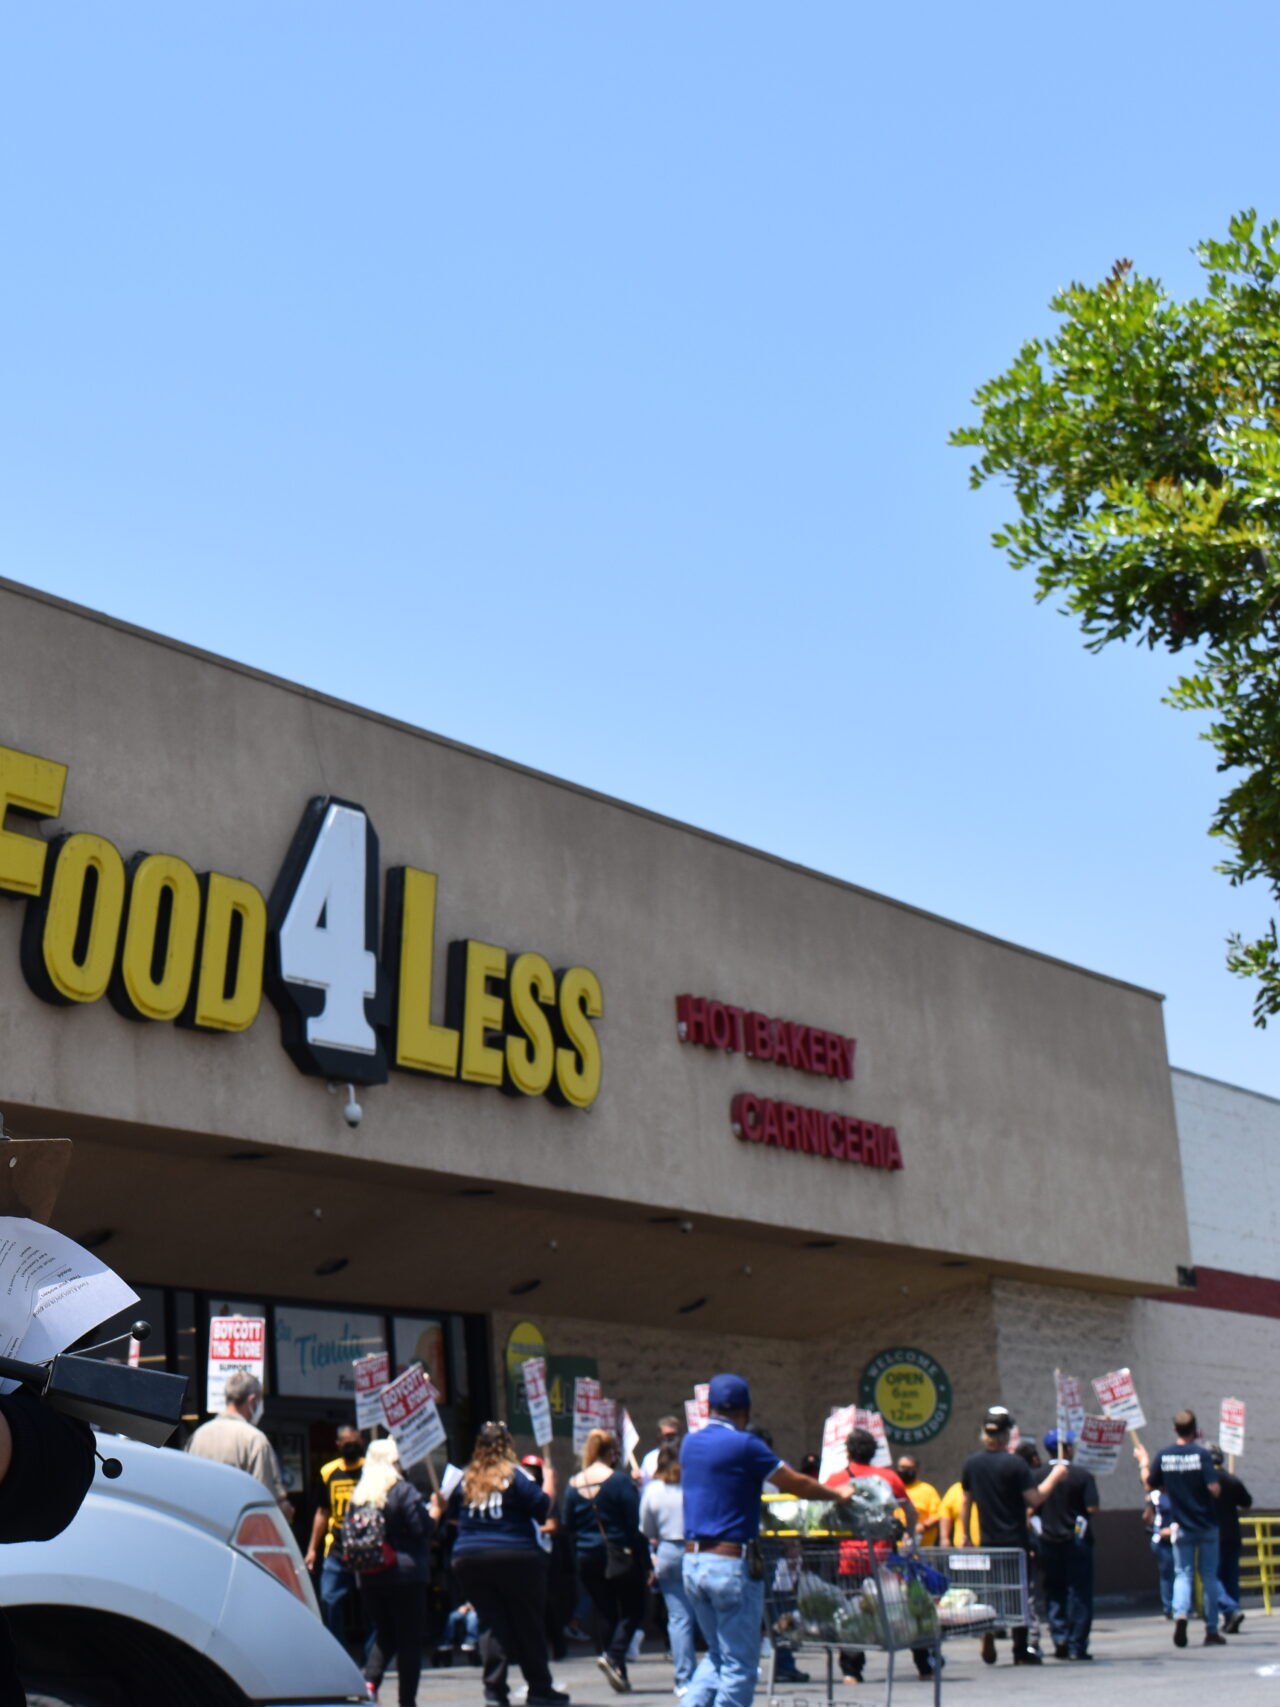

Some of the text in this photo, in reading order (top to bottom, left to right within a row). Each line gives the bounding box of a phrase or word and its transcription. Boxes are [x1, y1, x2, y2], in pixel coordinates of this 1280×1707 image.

[274, 799, 380, 1062] 4
[386, 864, 604, 1109] LESS
[675, 993, 858, 1082] HOT BAKERY
[730, 1092, 904, 1171] CARNICERIA
[211, 1320, 263, 1341] BOYCOTT
[233, 1340, 262, 1358] STORE
[867, 1350, 938, 1377] WELCOME
[885, 1371, 925, 1386] OPEN
